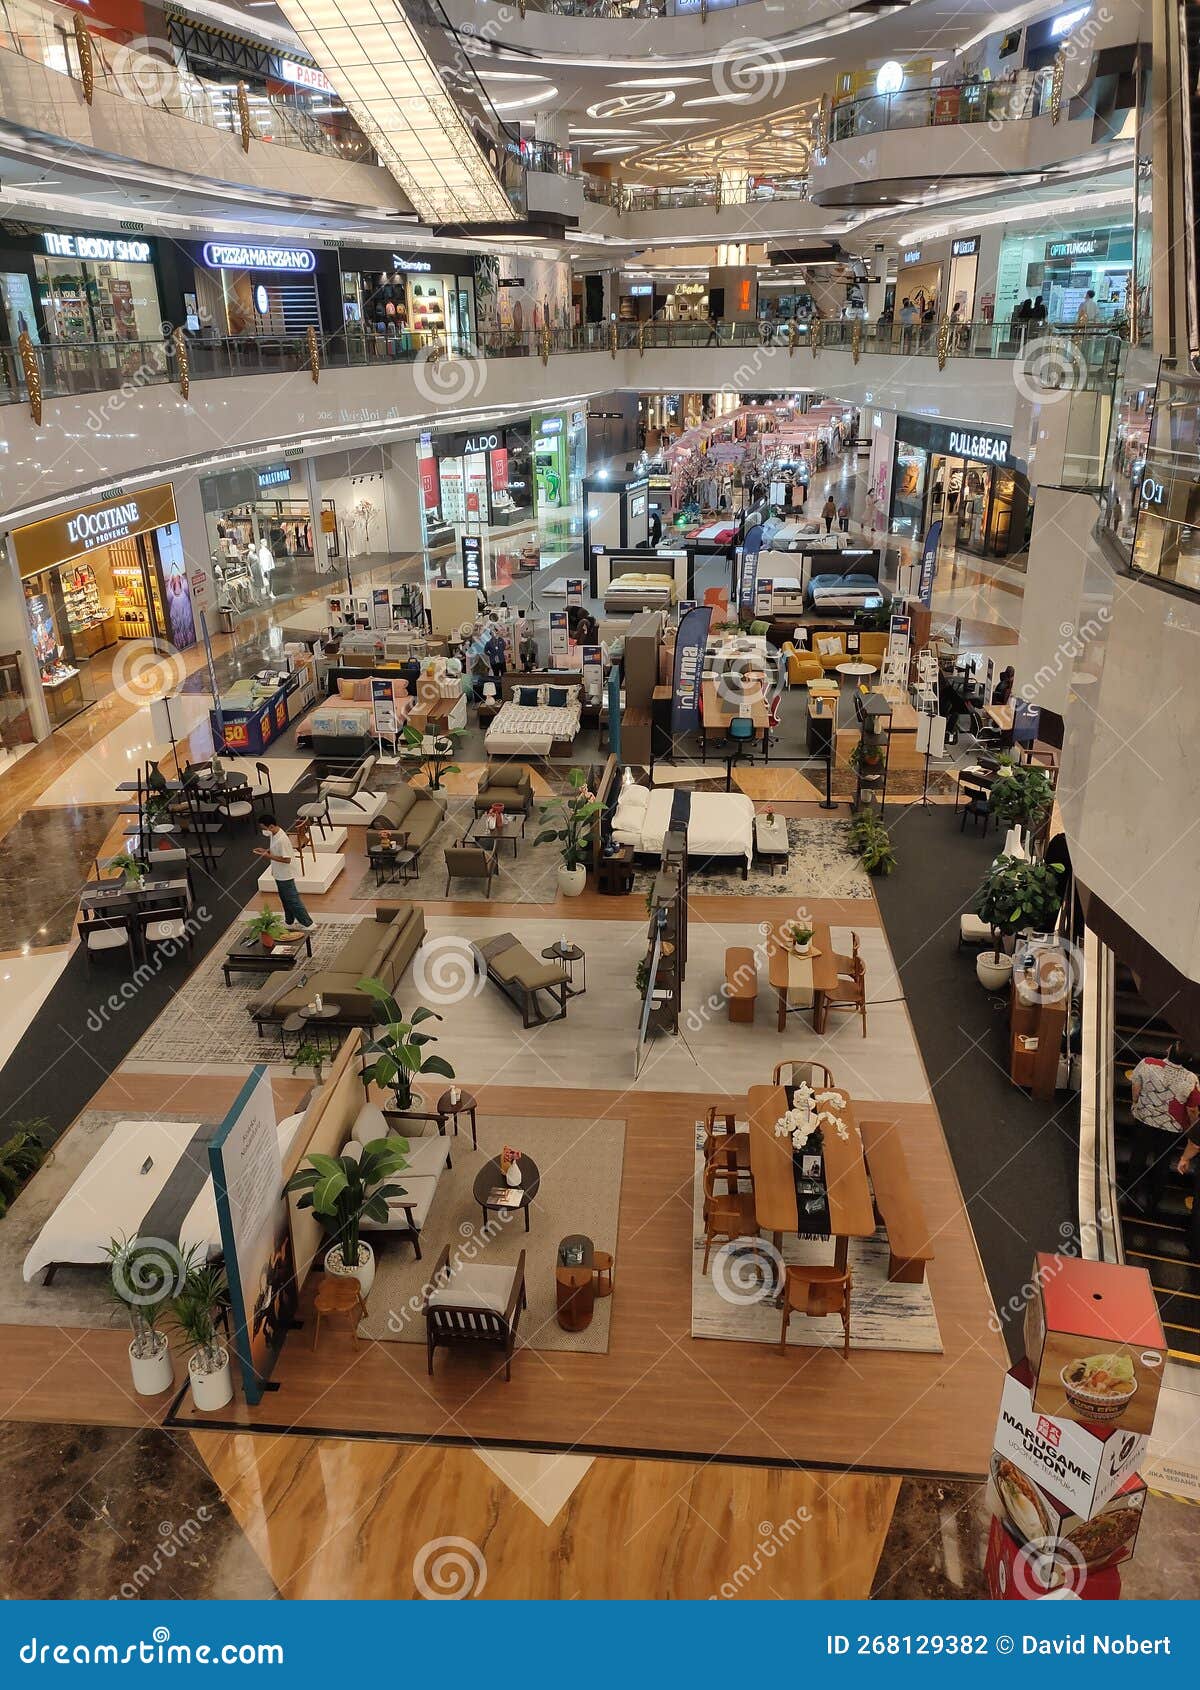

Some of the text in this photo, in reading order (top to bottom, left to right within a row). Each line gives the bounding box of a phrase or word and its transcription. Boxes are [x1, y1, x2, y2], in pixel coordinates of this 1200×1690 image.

[44, 232, 150, 262] THE BODY SHOP
[464, 434, 497, 453] ALDO
[949, 432, 1008, 462] PULL&BEAR
[67, 502, 139, 543] L'OCCITANE
[84, 526, 130, 548] EN PROVENCE
[676, 646, 698, 710] informa
[1003, 1411, 1092, 1486] MARUGAME
[1022, 1438, 1066, 1479] UDON
